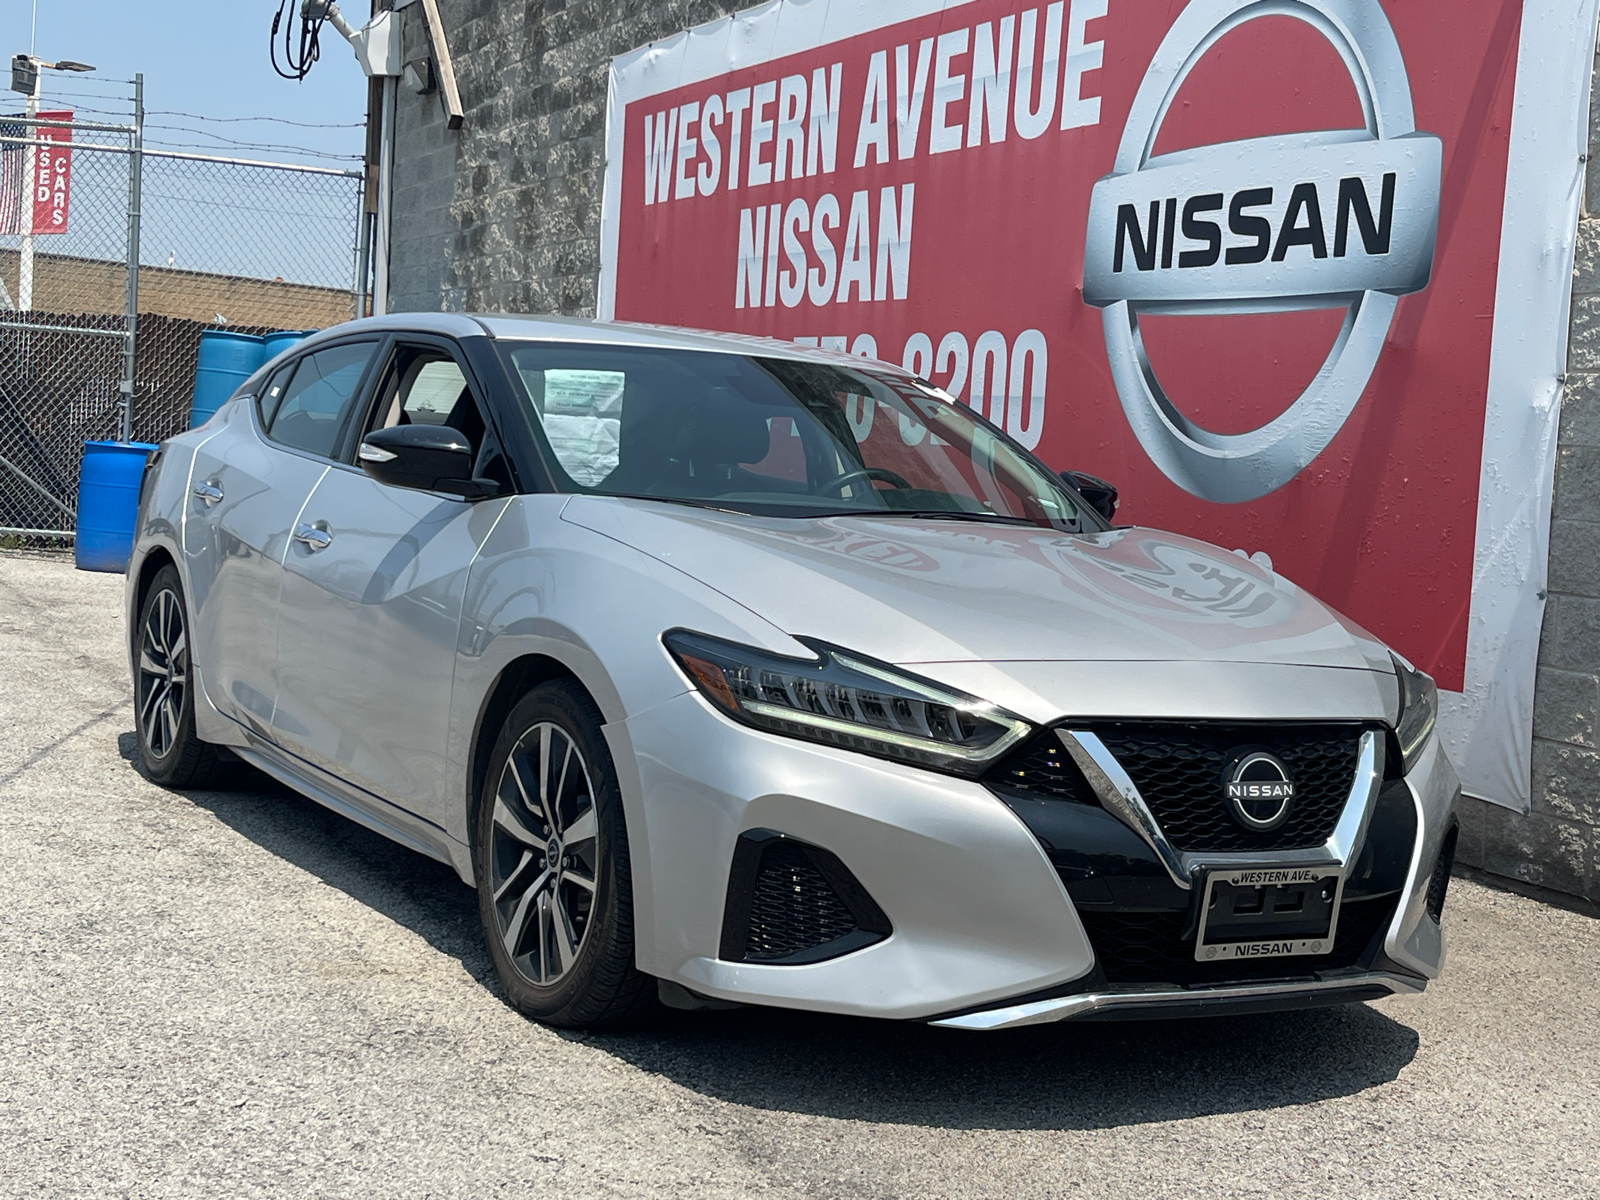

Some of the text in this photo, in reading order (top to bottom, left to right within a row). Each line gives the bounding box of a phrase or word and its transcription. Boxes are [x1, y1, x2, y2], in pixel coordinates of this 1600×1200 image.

[644, 0, 1108, 206] WESTERN AVENUE
[37, 134, 52, 202] USED
[52, 156, 67, 225] CARS
[735, 183, 915, 309] NISSAN
[1113, 172, 1396, 273] NISSAN
[1229, 784, 1293, 797] NISSAN
[1240, 871, 1289, 883] WESTERN
[1235, 942, 1293, 956] NISSAN
